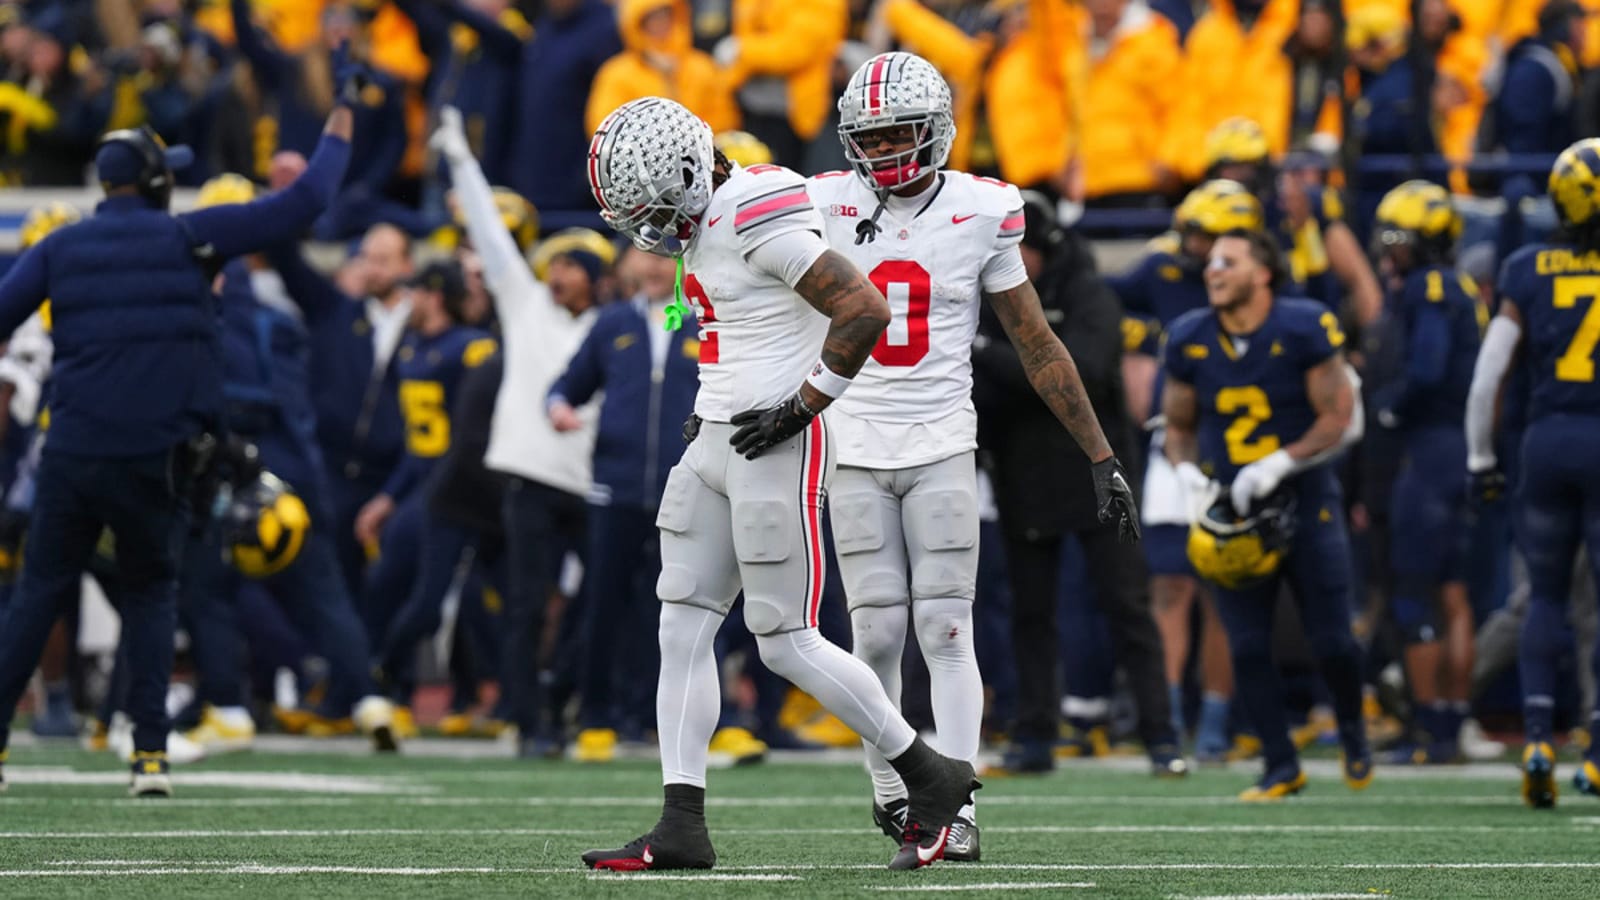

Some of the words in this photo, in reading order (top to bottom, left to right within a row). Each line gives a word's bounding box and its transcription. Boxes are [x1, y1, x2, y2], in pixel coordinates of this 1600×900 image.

[868, 260, 930, 366] 0
[1553, 276, 1600, 381] 7
[399, 380, 450, 457] 5
[1216, 386, 1280, 464] 2
